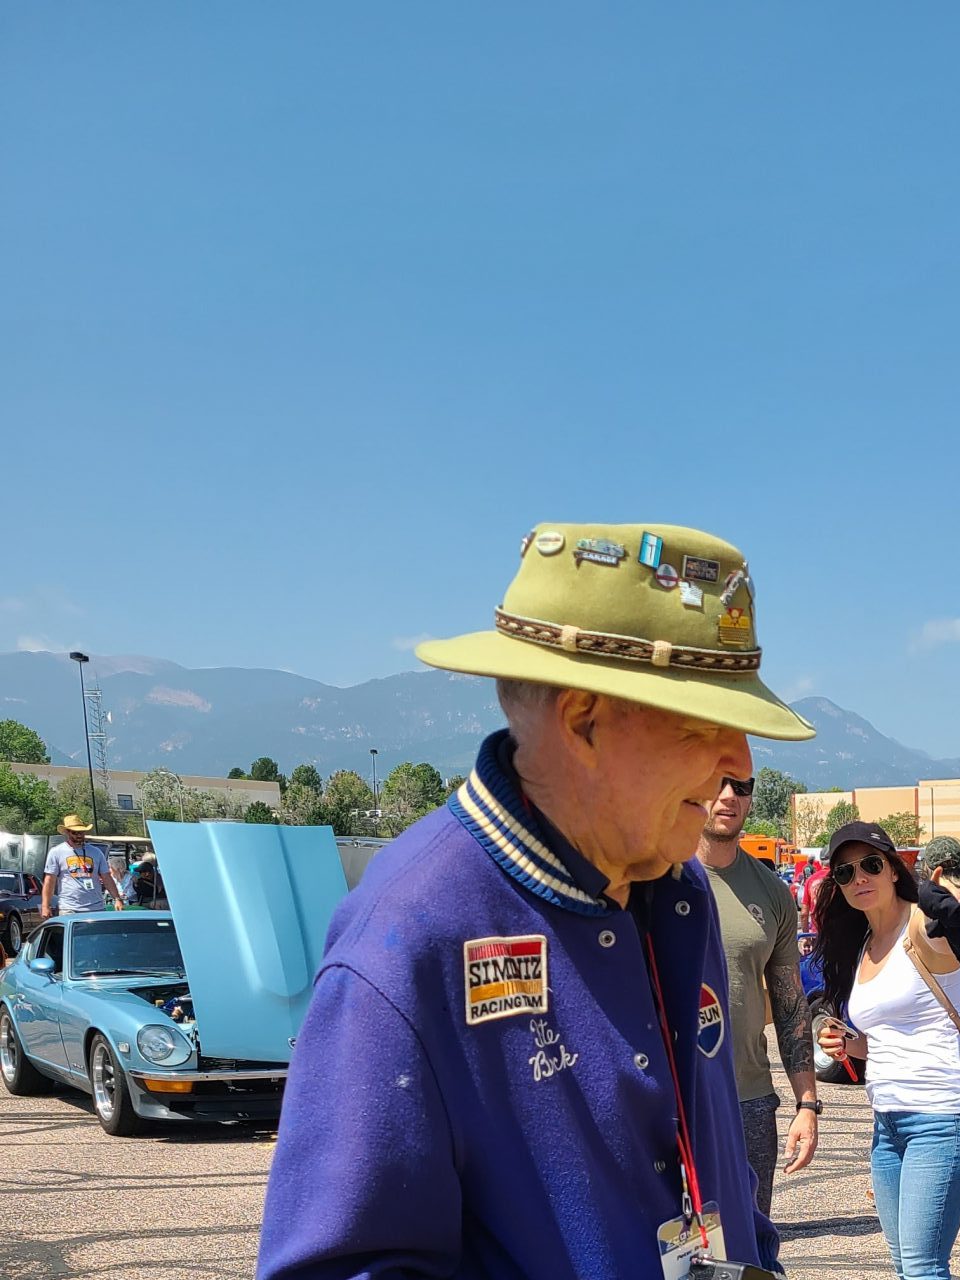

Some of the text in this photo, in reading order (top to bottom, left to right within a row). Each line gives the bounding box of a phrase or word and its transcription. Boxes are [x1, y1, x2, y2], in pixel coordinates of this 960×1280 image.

[469, 957, 542, 988] SIMNIZ
[471, 996, 522, 1019] RACING
[699, 1005, 720, 1025] SUN
